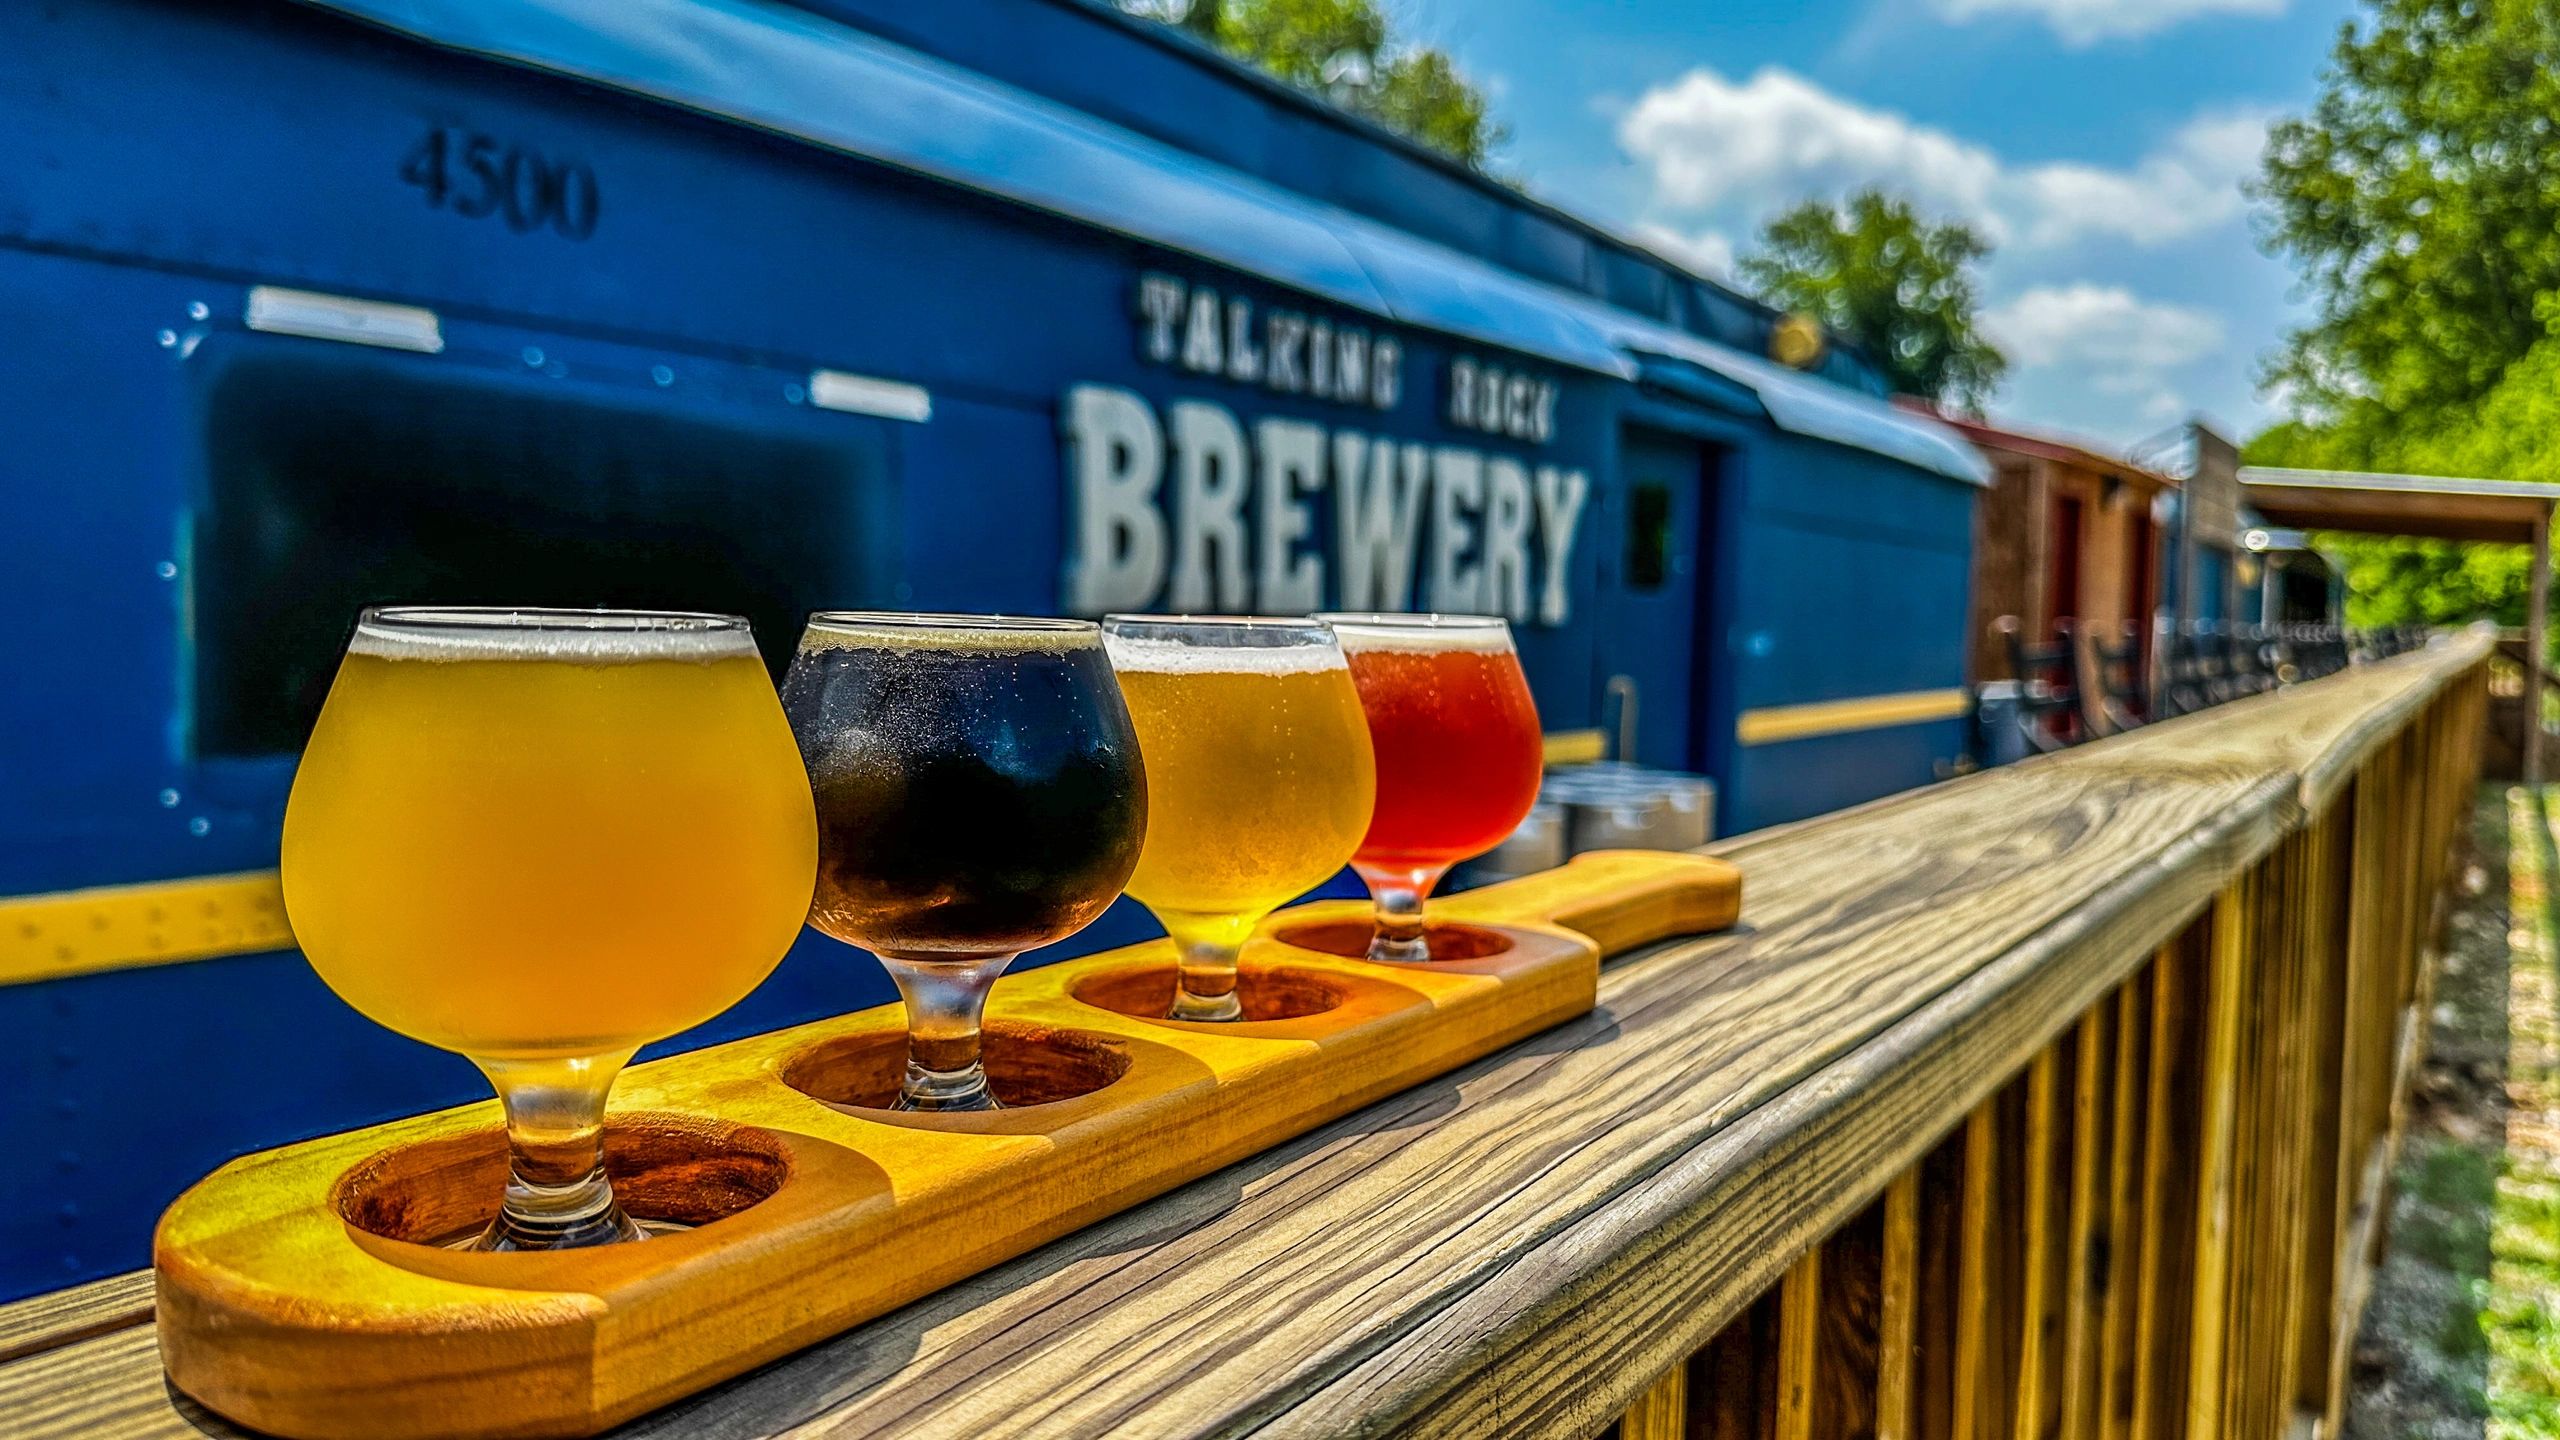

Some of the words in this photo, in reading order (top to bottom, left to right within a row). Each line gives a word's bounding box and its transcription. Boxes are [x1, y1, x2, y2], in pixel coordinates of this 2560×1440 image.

[399, 129, 600, 241] 4500
[1140, 274, 1402, 409] TALKING
[1450, 357, 1560, 443] ROCK
[1067, 384, 1589, 626] BREWERY
